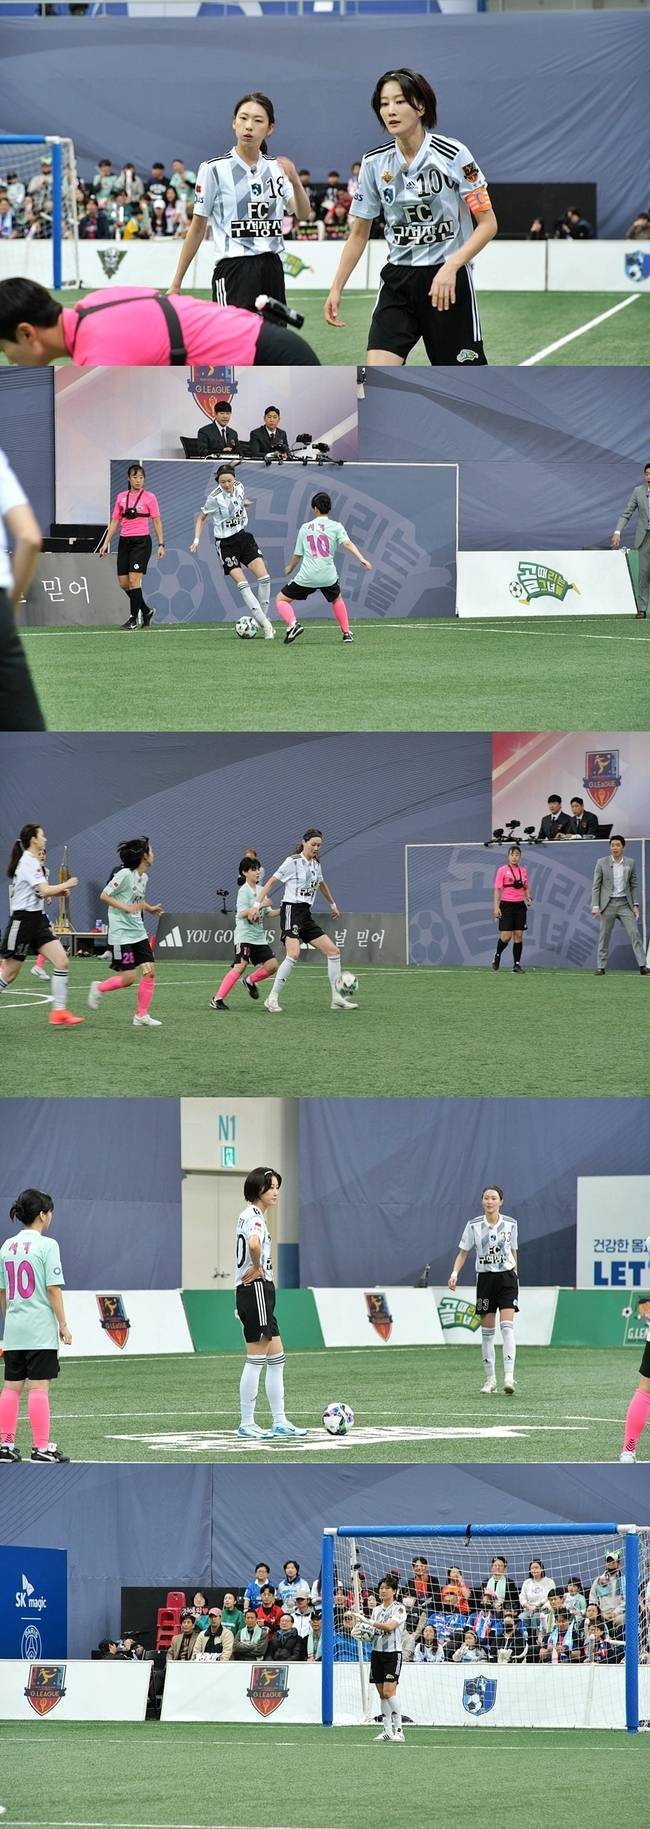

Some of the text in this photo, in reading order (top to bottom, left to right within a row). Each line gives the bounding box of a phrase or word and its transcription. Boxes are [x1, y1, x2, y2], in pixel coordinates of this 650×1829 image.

[248, 202, 269, 220] FC
[403, 204, 433, 222] FC
[231, 221, 283, 237] 구척장신
[393, 222, 455, 244] 구척장신
[306, 534, 331, 559] 10
[519, 562, 542, 595] 골
[41, 576, 90, 604] 믿어
[186, 929, 211, 943] YOU
[214, 929, 236, 943] GO
[335, 929, 385, 949] 널 믿어
[219, 1115, 236, 1141] N1
[500, 1231, 512, 1243] 33
[594, 1238, 629, 1253] 건강한
[4, 1259, 36, 1300] 10
[438, 1297, 461, 1327] 골
[15, 1592, 47, 1612] SK magic
